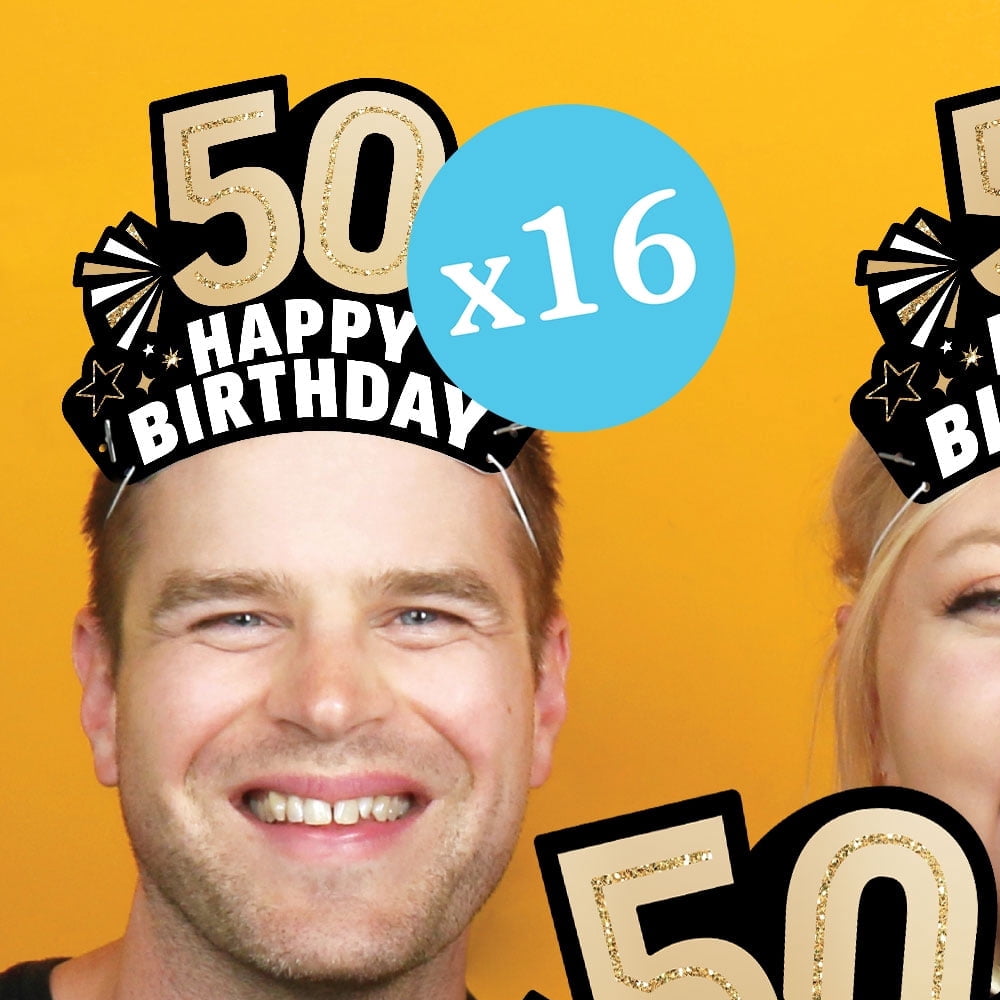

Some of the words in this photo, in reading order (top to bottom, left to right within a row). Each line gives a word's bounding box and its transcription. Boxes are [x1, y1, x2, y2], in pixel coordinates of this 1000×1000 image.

[161, 89, 447, 307] 50
[186, 298, 417, 376] HAPPY
[128, 357, 489, 467] BIRTHDAY
